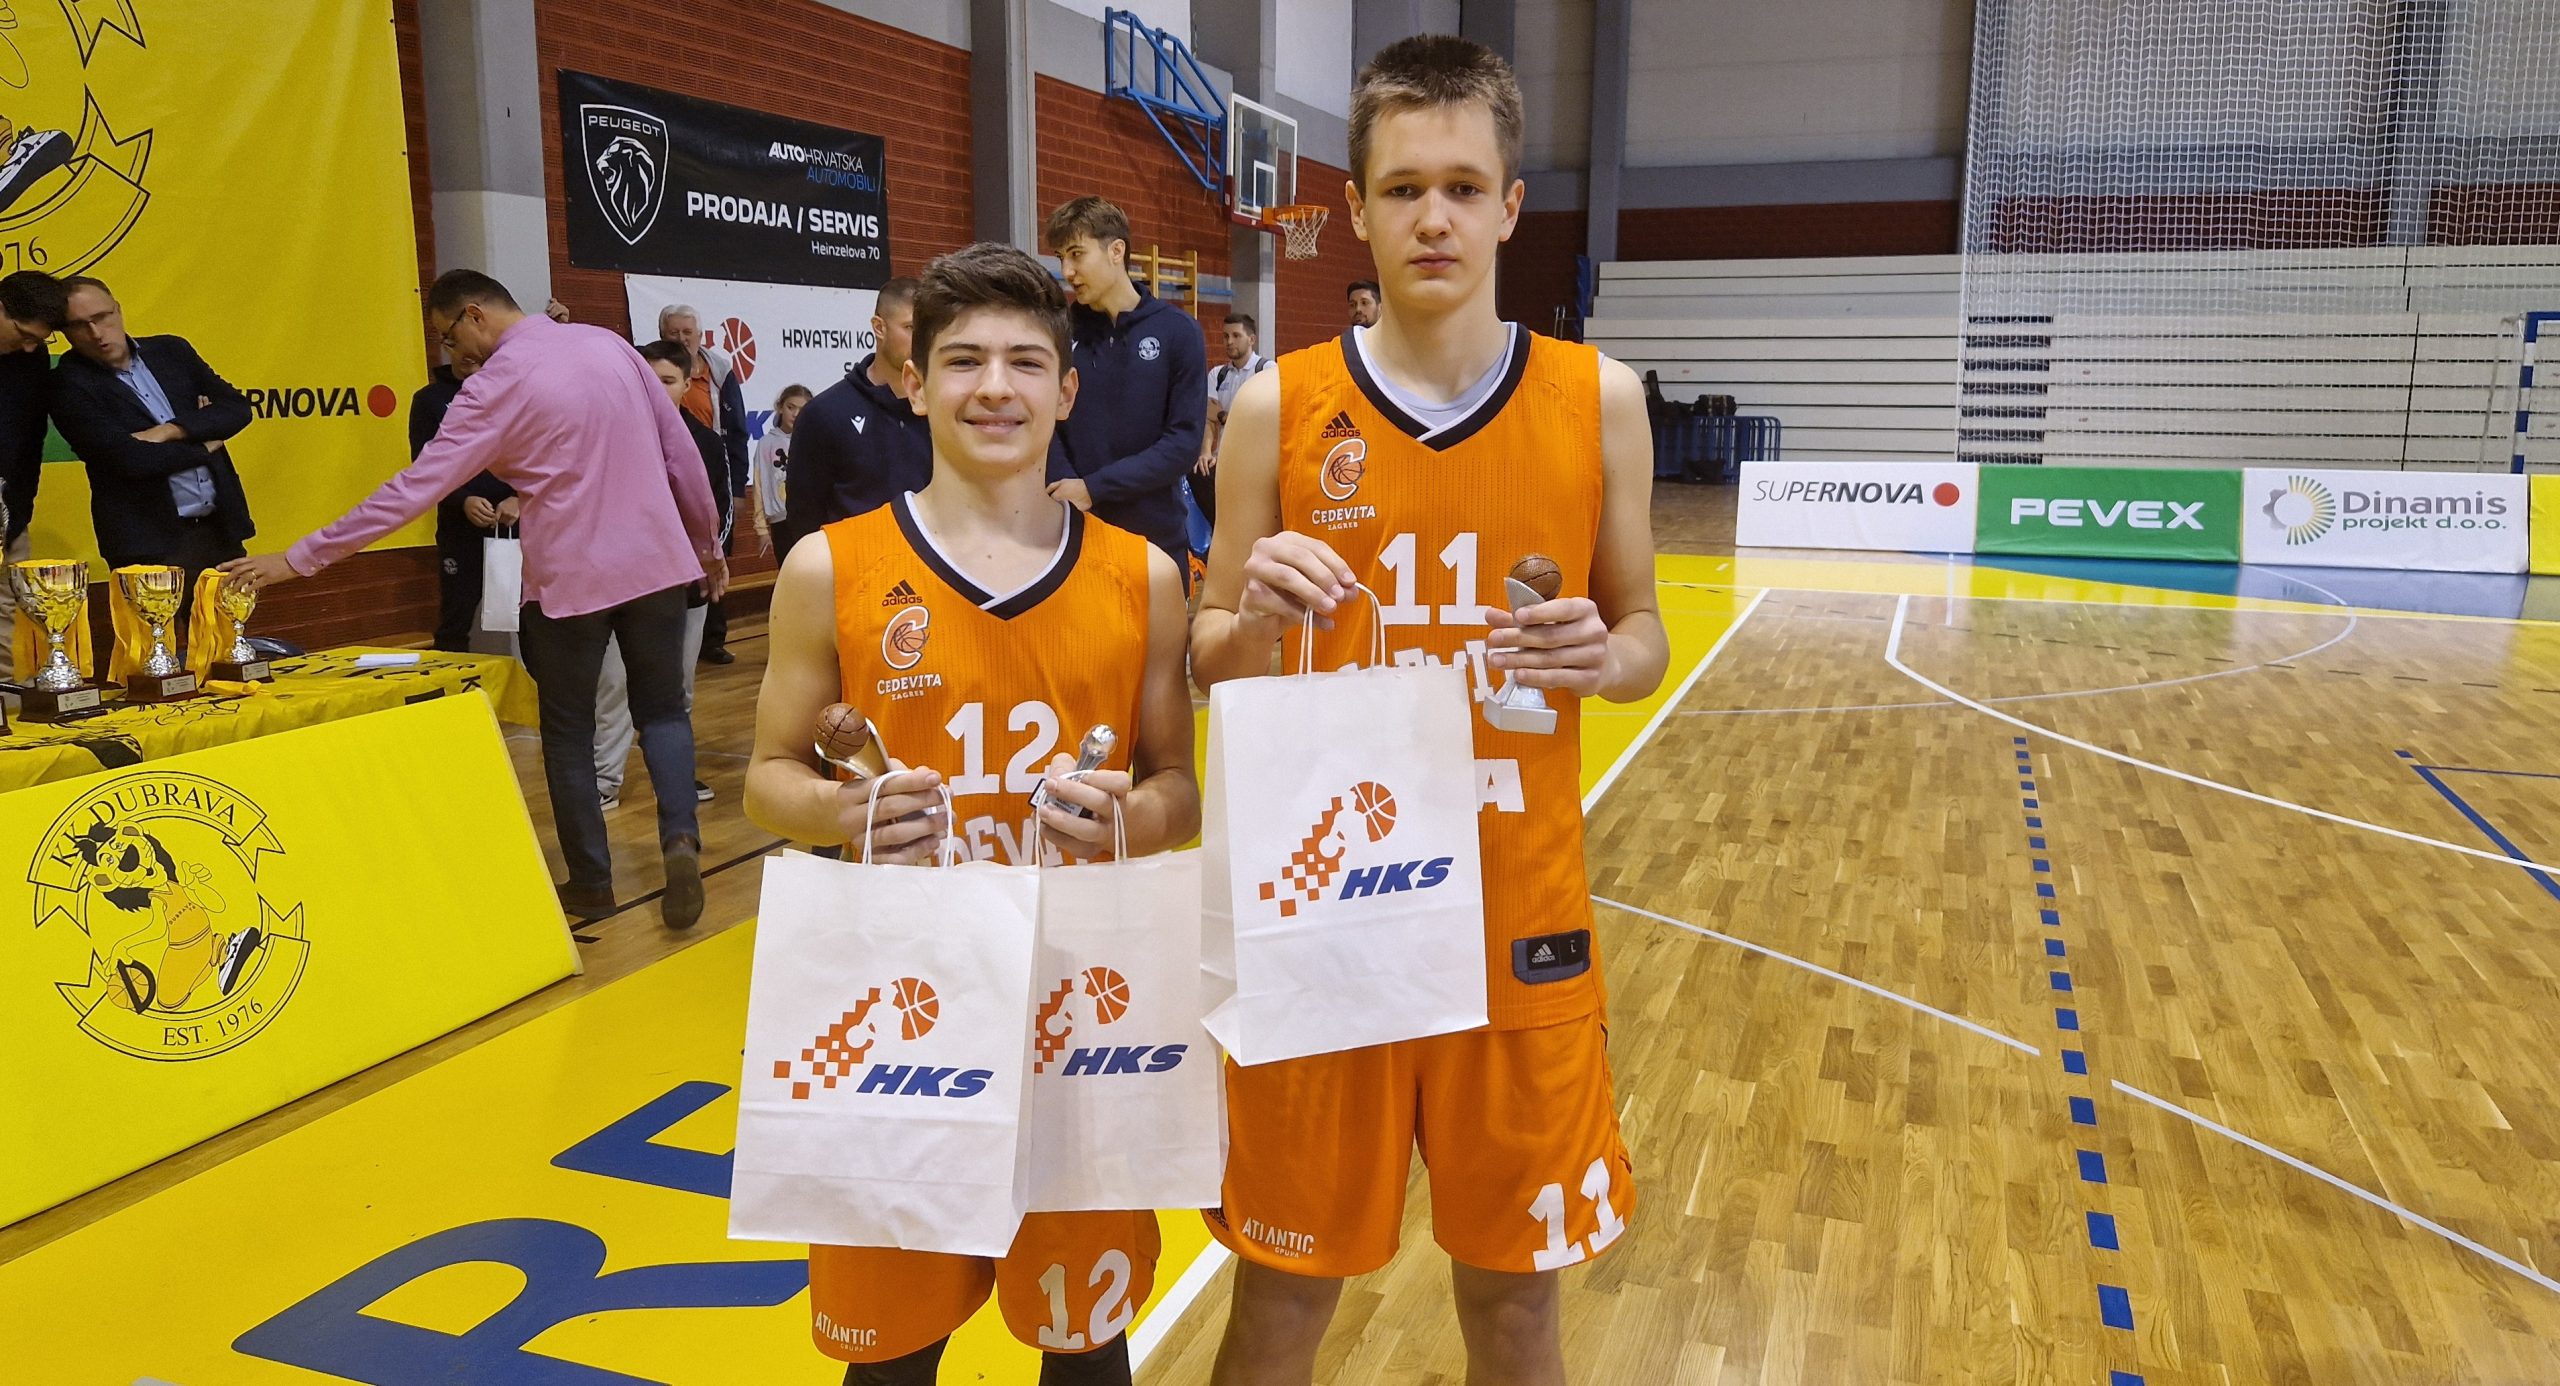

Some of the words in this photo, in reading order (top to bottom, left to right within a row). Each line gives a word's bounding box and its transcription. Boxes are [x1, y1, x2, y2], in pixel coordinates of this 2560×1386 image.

[588, 115, 661, 137] PEUGEOT
[768, 141, 864, 173] AUTOHRVATSKA
[807, 166, 877, 192] AUTOMOBILI
[687, 191, 793, 229] PRODAJA
[808, 207, 879, 239] SERVIS
[0, 236, 48, 270] 76
[811, 240, 867, 259] Heinzelova
[868, 246, 880, 260] 70
[782, 328, 852, 349] HRVATSKI
[240, 388, 360, 418] RNOVA
[1321, 428, 1361, 439] adidas
[1753, 480, 1924, 504] SUPERNOVA
[2343, 490, 2507, 515] Dinamis
[1311, 505, 1376, 525] CEDEVITA
[1327, 521, 1358, 531] ZAGREB
[2010, 498, 2205, 530] PEVEX
[2343, 516, 2428, 532] projekt
[2435, 516, 2507, 530] d.o.o.
[1378, 532, 1492, 626] 11
[881, 595, 923, 607] adidas
[877, 674, 942, 695] CEDEVITA
[891, 690, 924, 701] ZAGREB
[945, 700, 1060, 796] 12
[86, 783, 236, 828] DUBRAVA
[1338, 857, 1453, 900] HKS
[1531, 955, 1556, 964] adidas
[162, 1025, 209, 1046] EST.
[216, 997, 263, 1038] 1976
[1061, 1044, 1188, 1076] HKS
[856, 1064, 994, 1098] HKS
[1528, 1156, 1625, 1271] 11
[1242, 1217, 1315, 1255] ATLANTIC
[1038, 1249, 1134, 1350] 12
[815, 1311, 877, 1346] ATLANTIC
